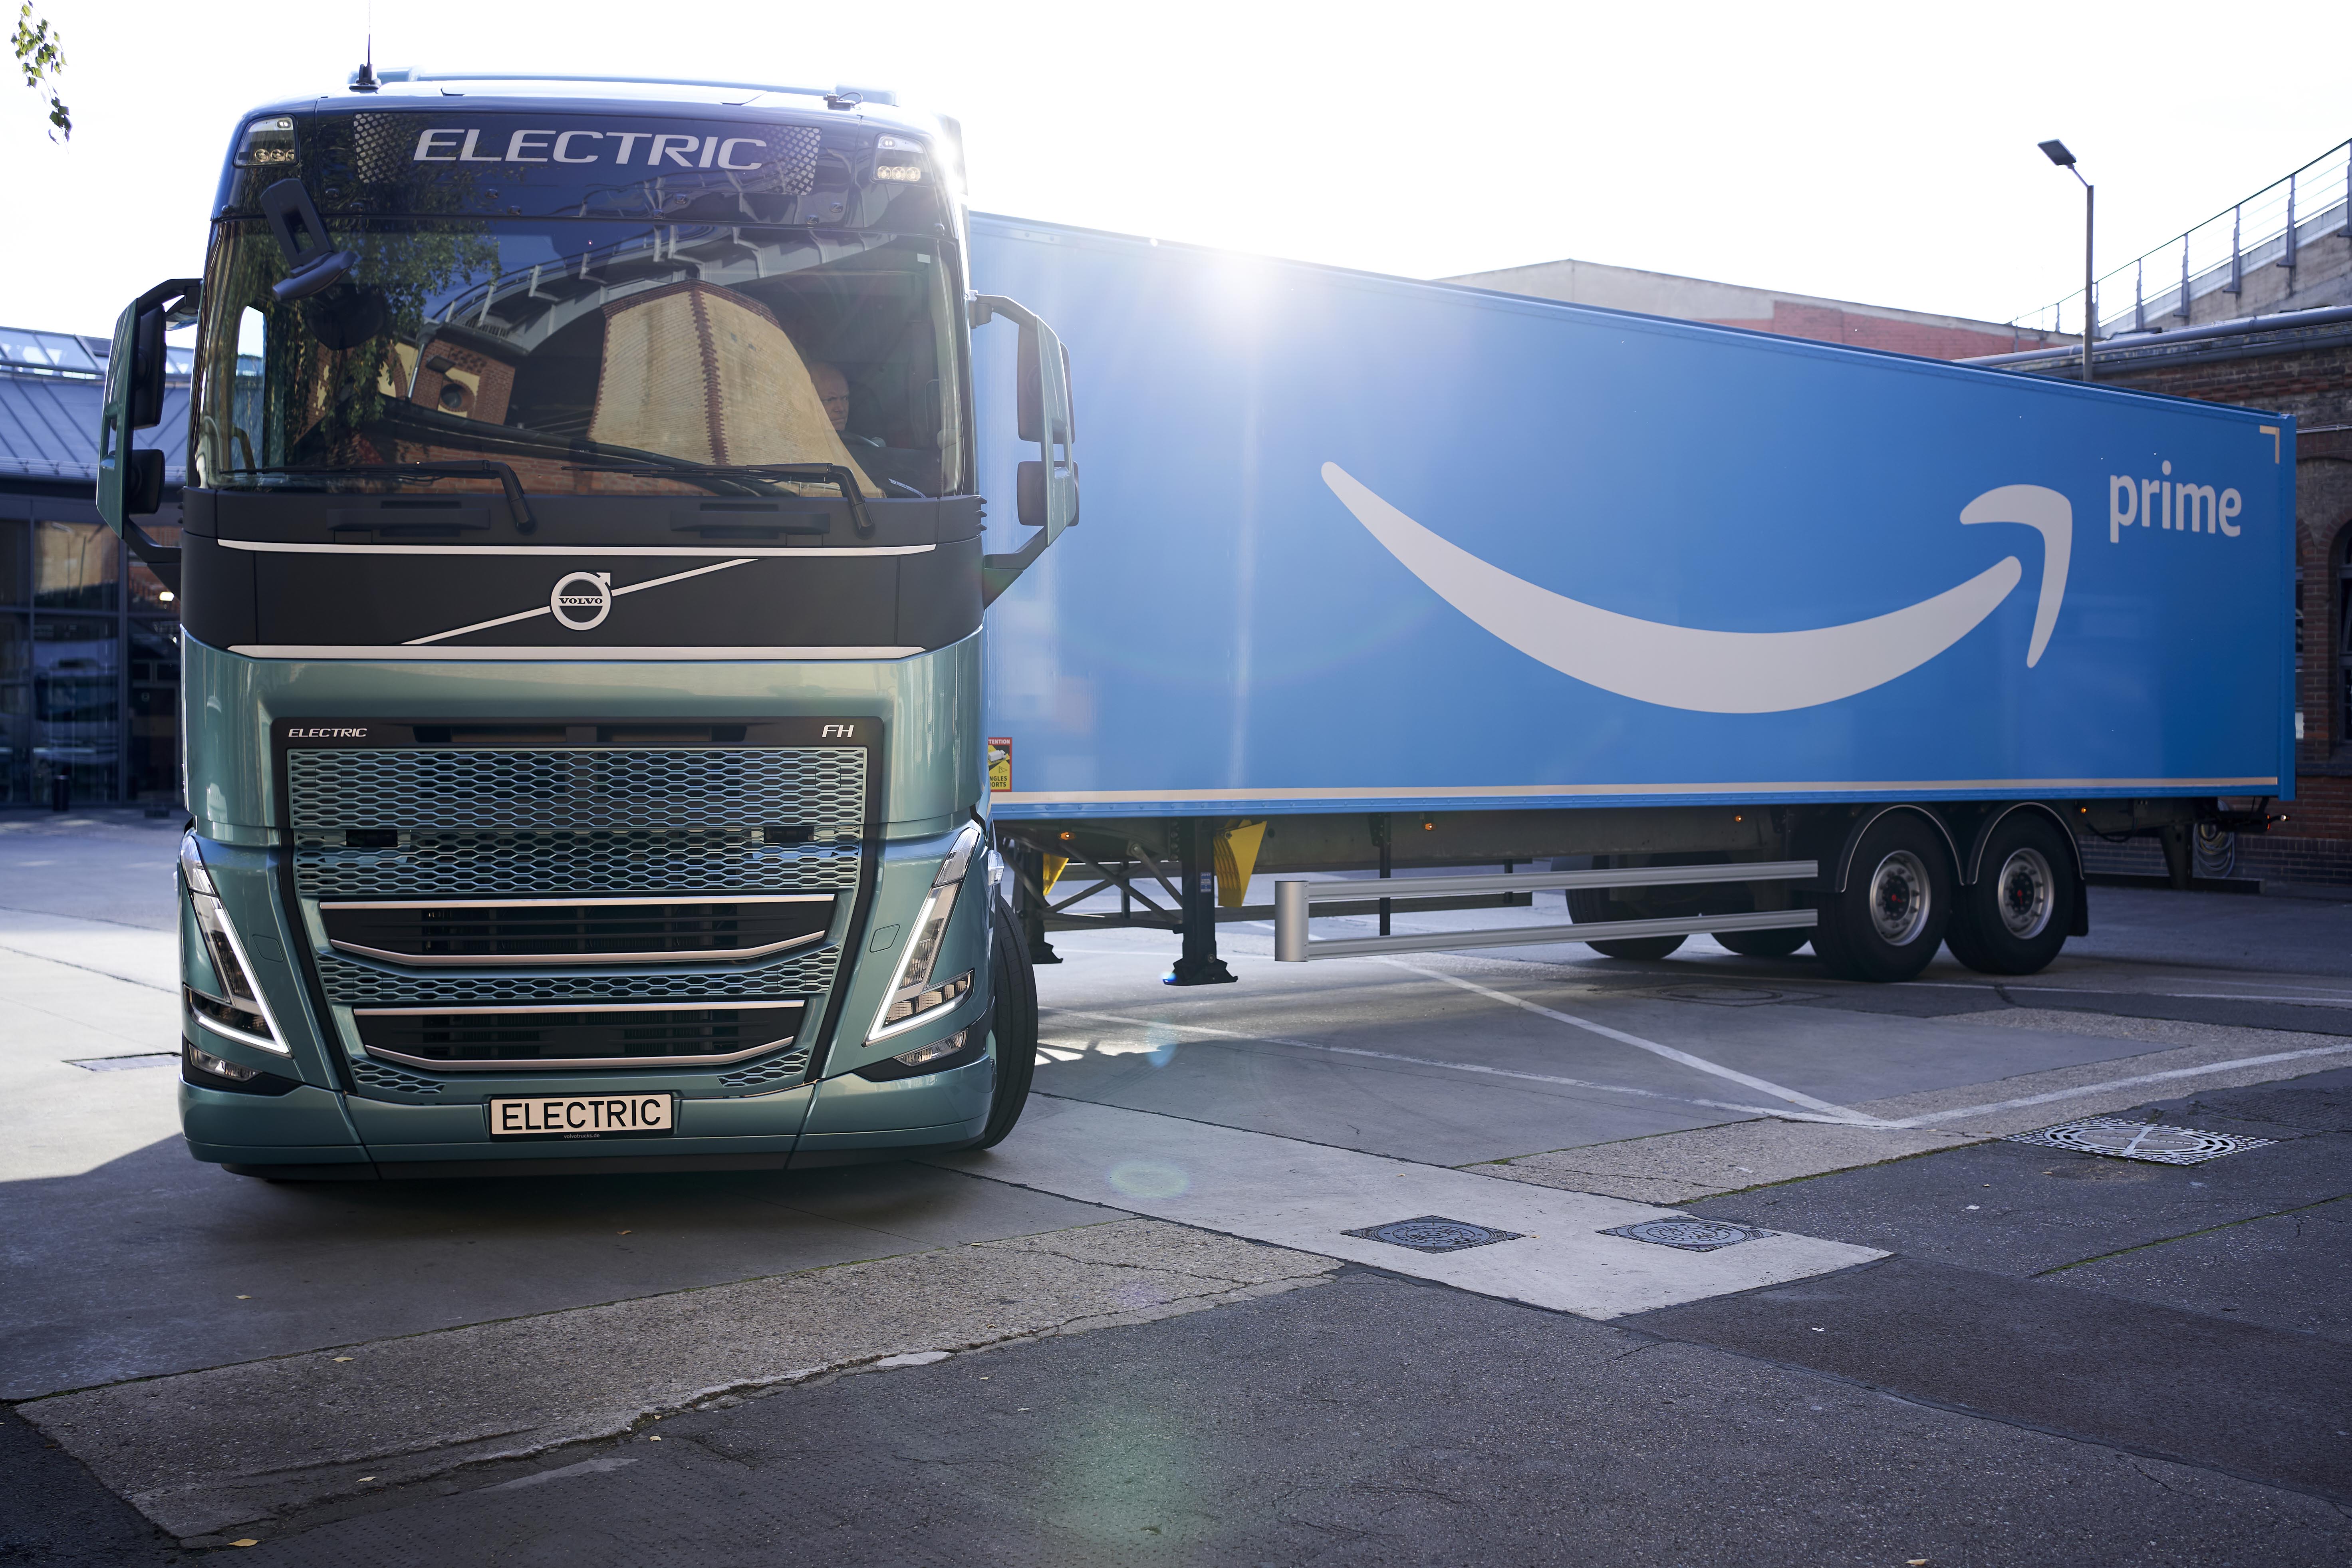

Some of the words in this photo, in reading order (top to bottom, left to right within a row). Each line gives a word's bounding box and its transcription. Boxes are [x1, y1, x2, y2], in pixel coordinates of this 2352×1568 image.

[413, 129, 767, 171] ELECTRIC
[2110, 460, 2242, 543] prime
[288, 728, 367, 737] ELECTRIC
[822, 725, 854, 737] FH
[502, 1099, 661, 1130] ELECTRIC
